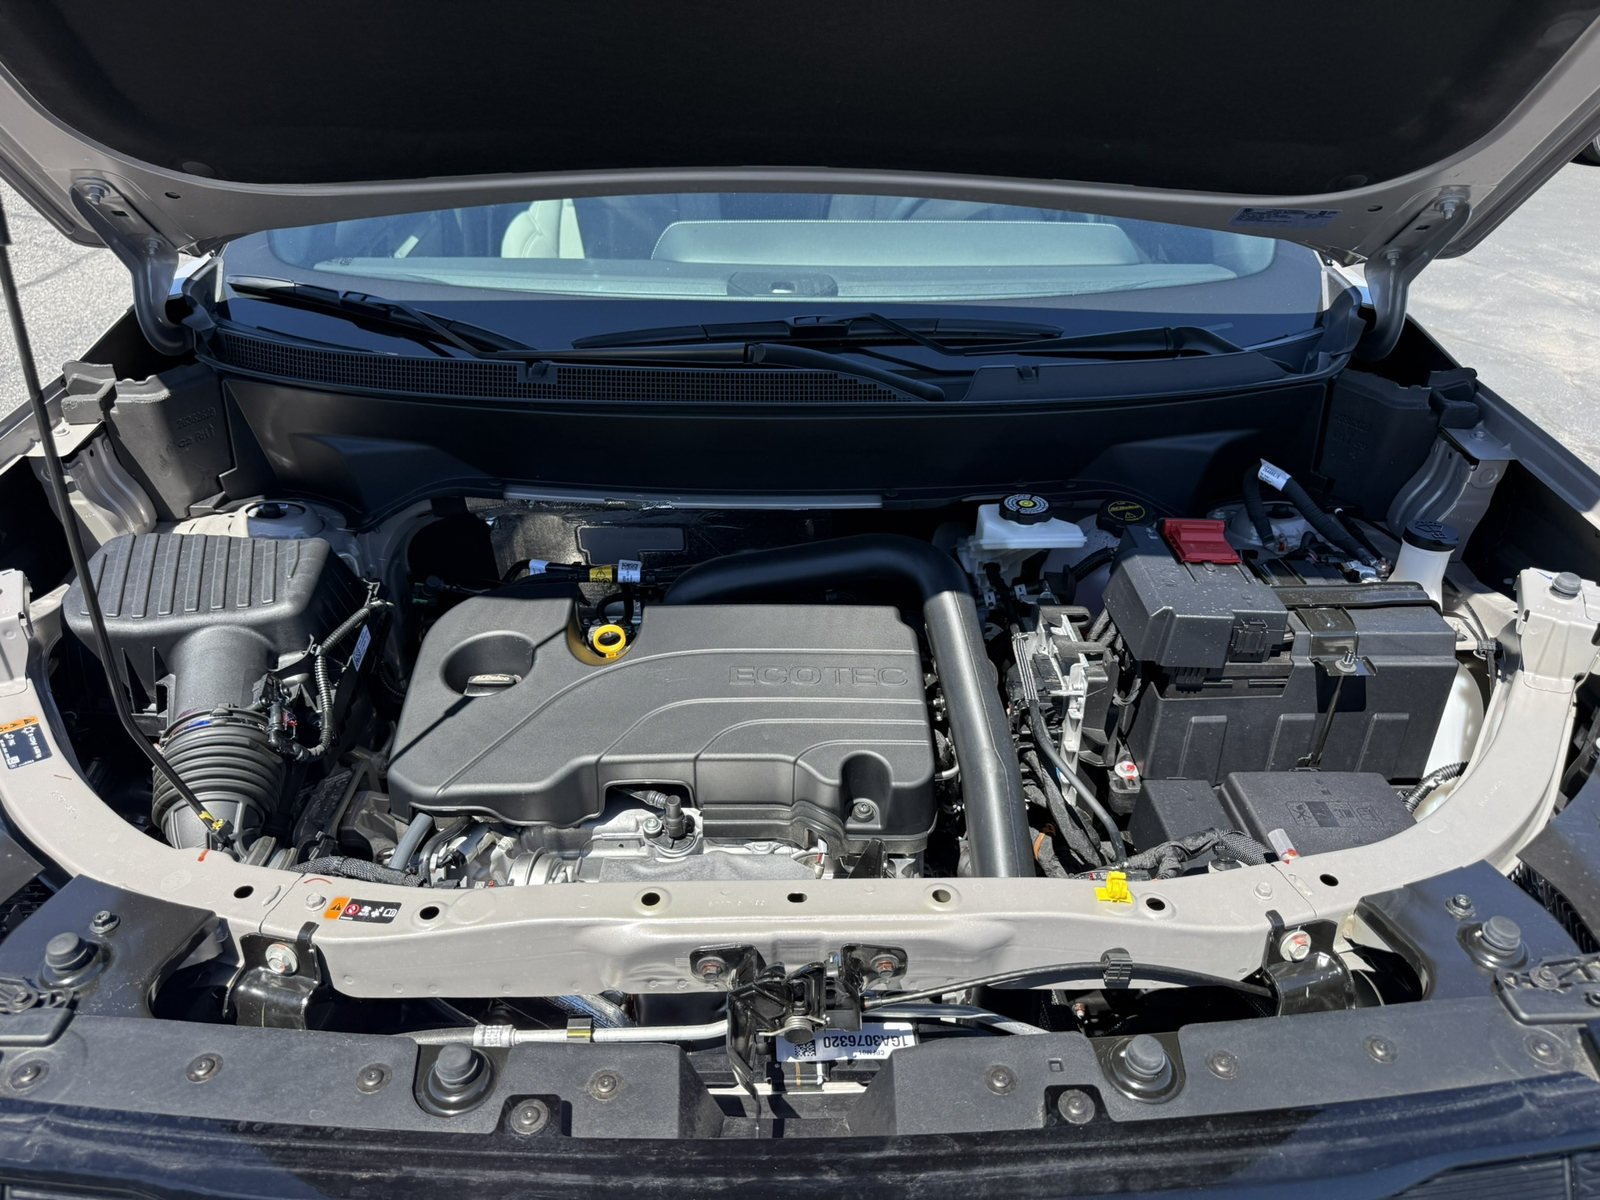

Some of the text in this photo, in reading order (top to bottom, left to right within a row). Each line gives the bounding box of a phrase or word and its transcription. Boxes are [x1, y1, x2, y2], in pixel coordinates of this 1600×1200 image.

[195, 428, 209, 442] RH
[472, 674, 510, 682] ACDelco
[729, 665, 908, 687] ECOTEC
[823, 1034, 909, 1048] 1GA3076320
